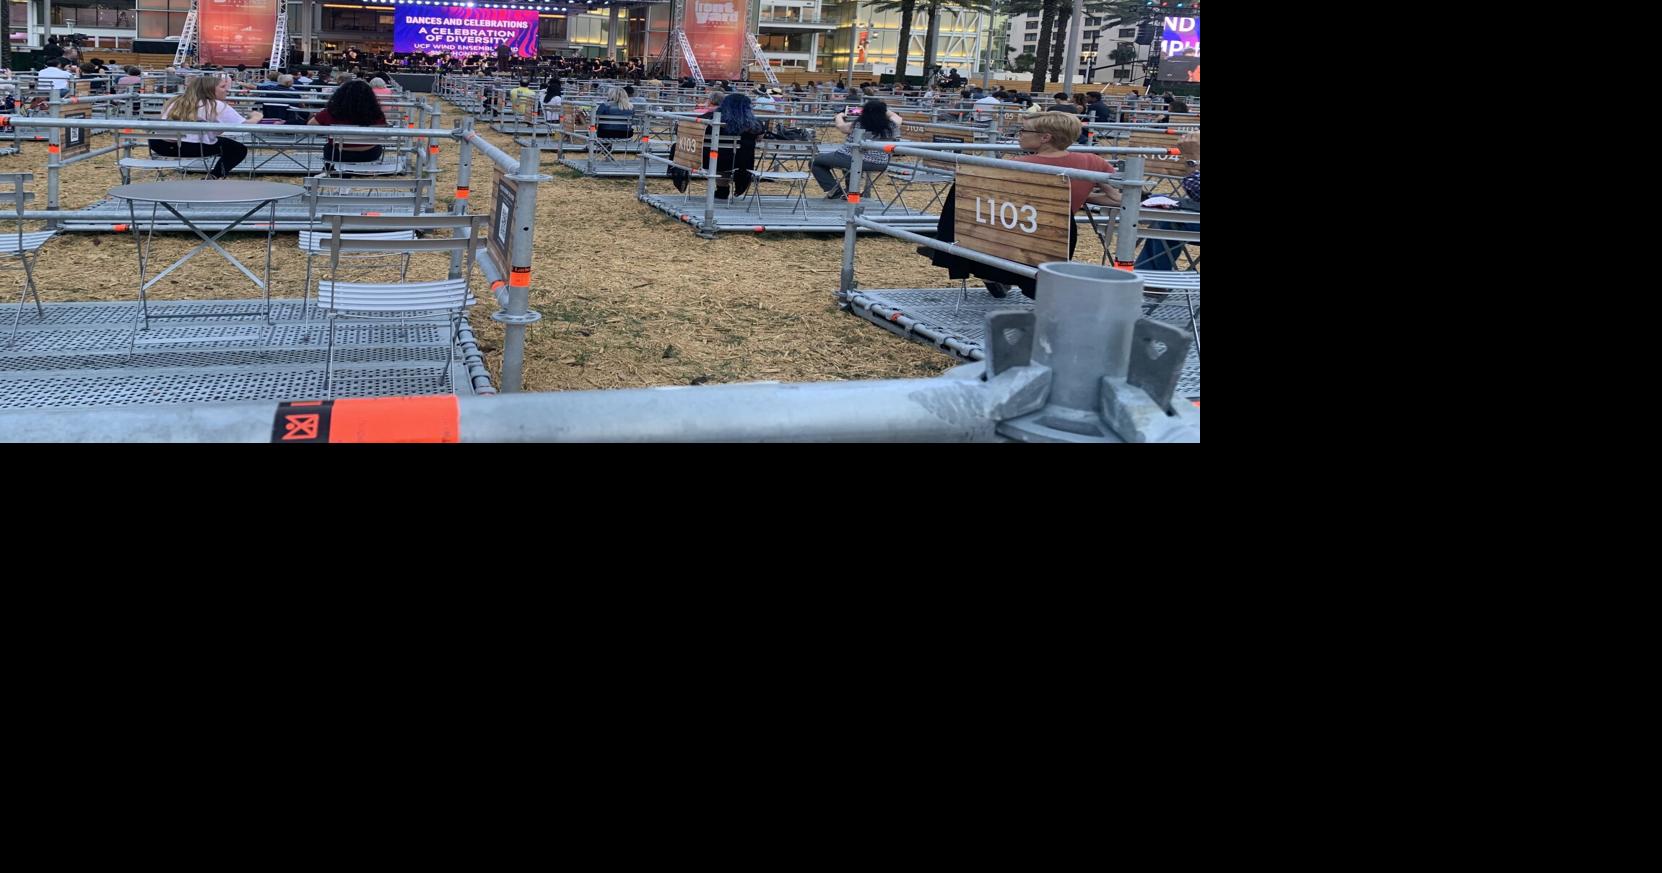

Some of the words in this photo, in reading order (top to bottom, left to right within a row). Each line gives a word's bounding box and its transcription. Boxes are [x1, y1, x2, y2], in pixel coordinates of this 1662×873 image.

[406, 16, 442, 25] DANCES
[443, 18, 462, 26] AND
[463, 19, 528, 29] CELEBRATIONS
[431, 28, 515, 37] CELEBRATION
[446, 35, 509, 44] DIVERSITY
[679, 136, 697, 153] K103
[975, 196, 1038, 234] L103
